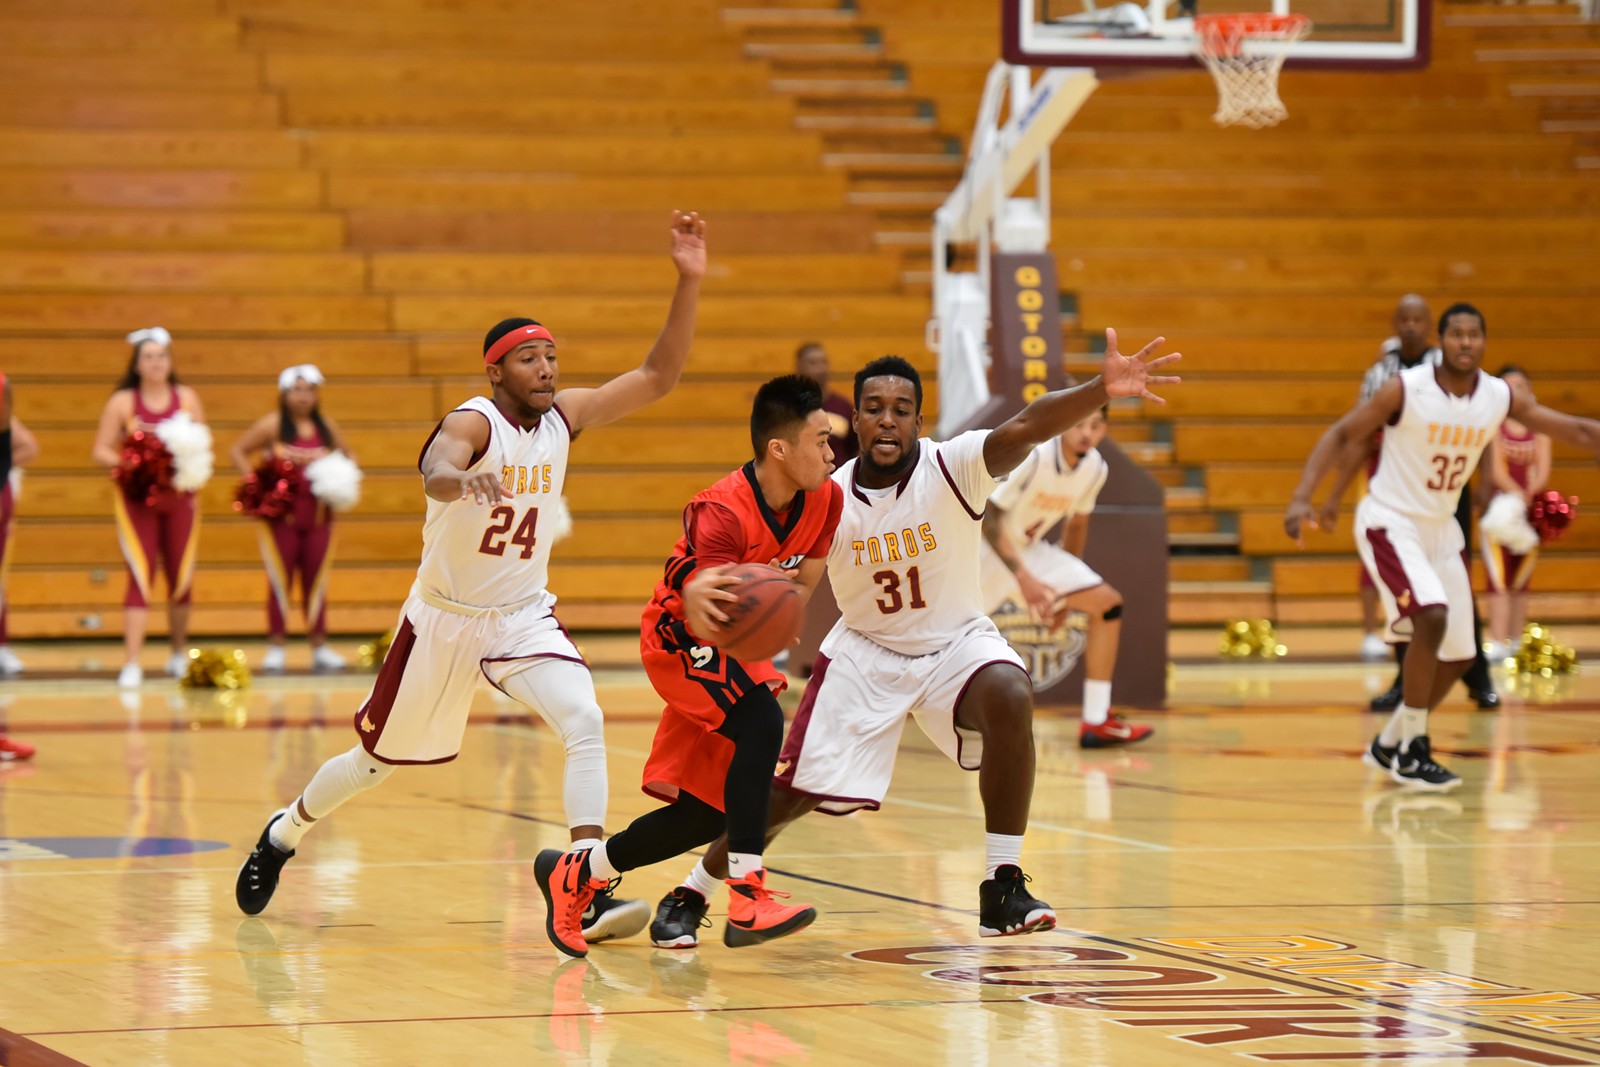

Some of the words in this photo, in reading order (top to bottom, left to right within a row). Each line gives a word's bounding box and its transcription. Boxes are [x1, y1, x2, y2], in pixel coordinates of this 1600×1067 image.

[1426, 453, 1468, 491] 32
[478, 505, 539, 560] 24
[851, 522, 938, 566] TOROS
[872, 565, 927, 615] 31
[842, 943, 1600, 1067] COURT
